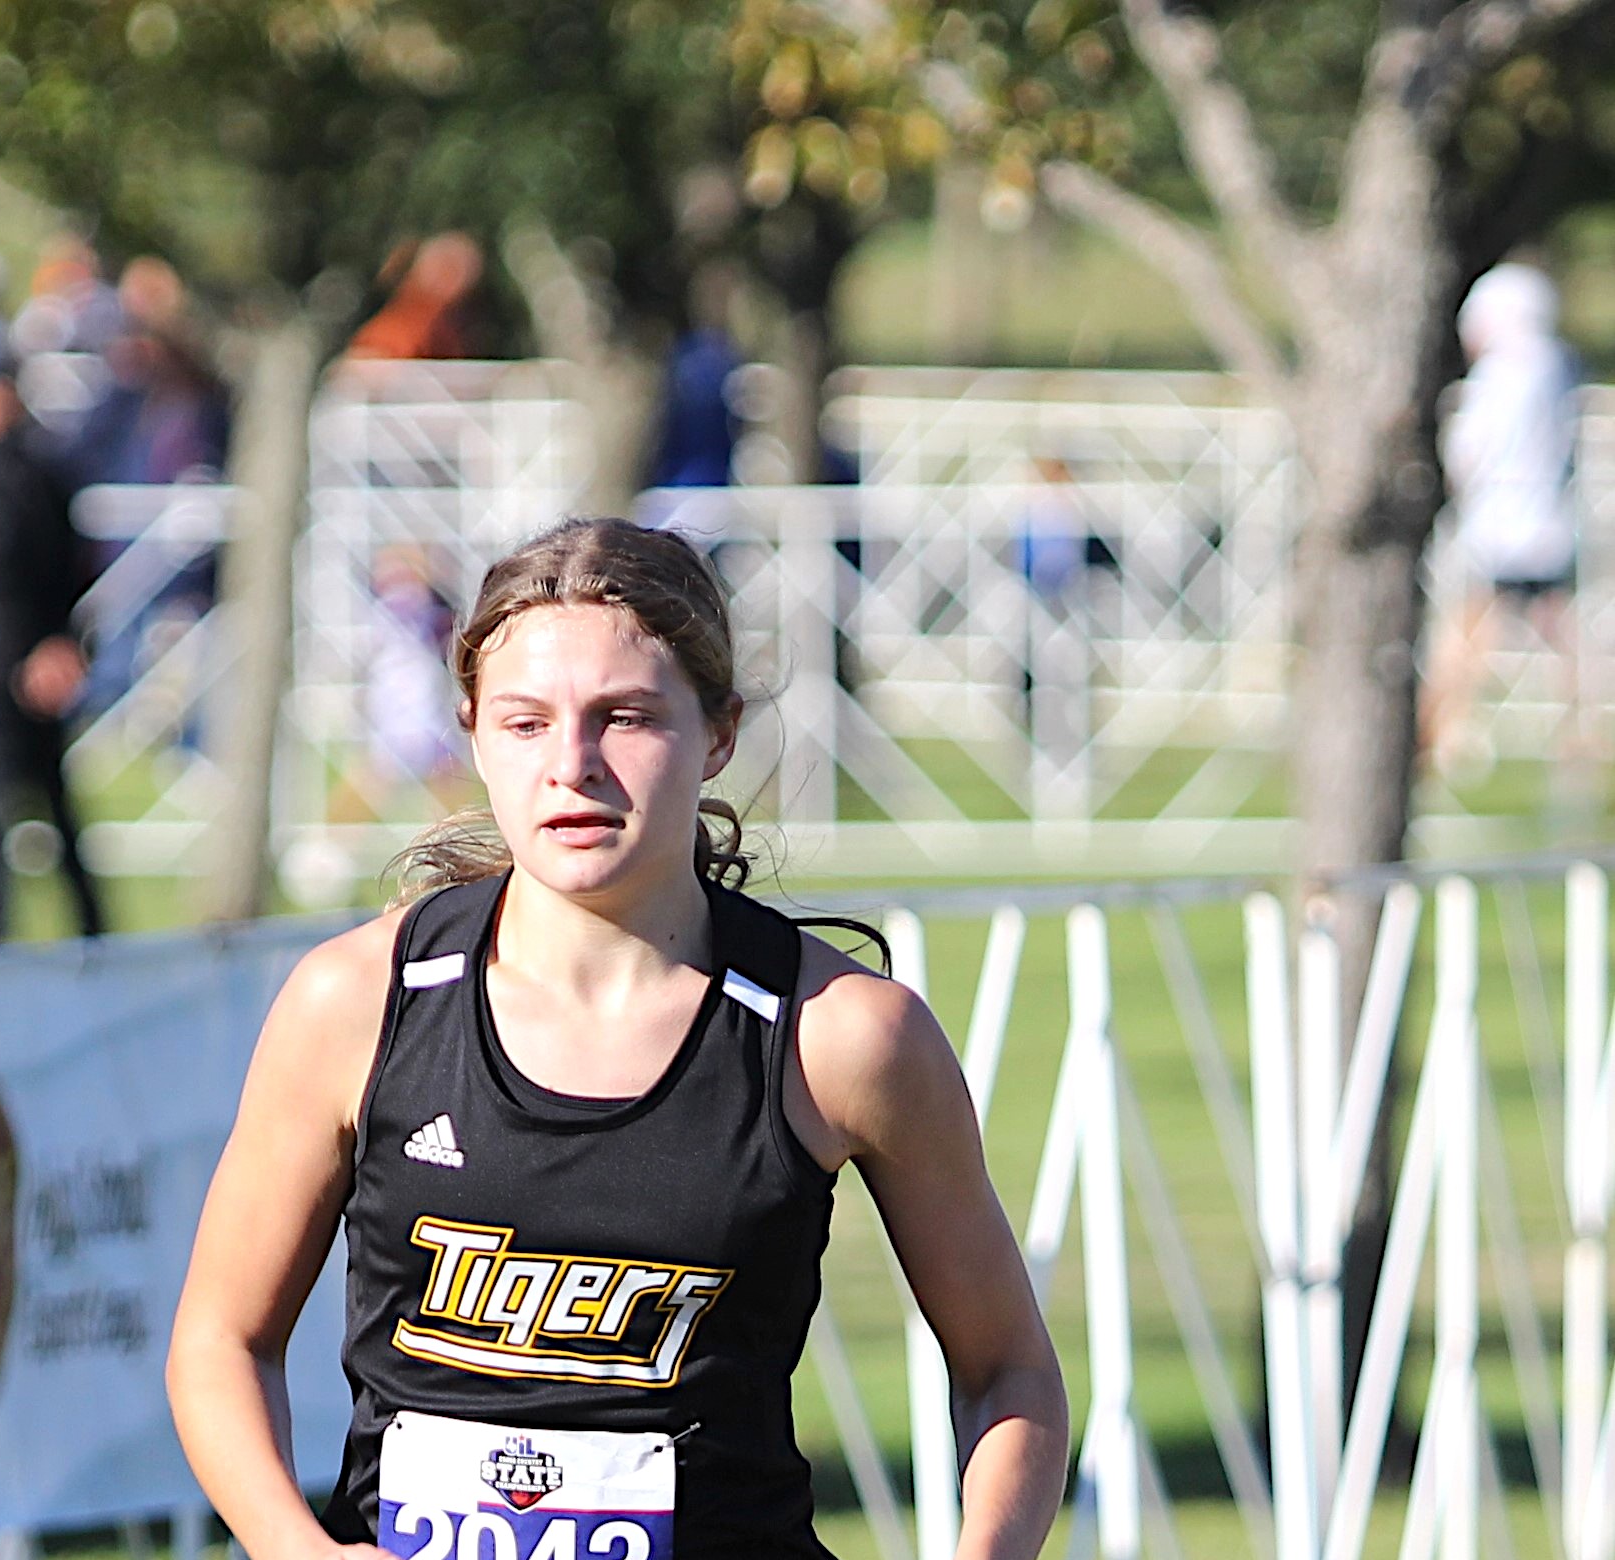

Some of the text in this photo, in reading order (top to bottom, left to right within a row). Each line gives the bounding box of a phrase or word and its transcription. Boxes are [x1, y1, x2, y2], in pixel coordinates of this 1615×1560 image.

[404, 1140, 465, 1168] adidas
[392, 1215, 735, 1388] Tigers
[481, 1461, 562, 1487] STATE
